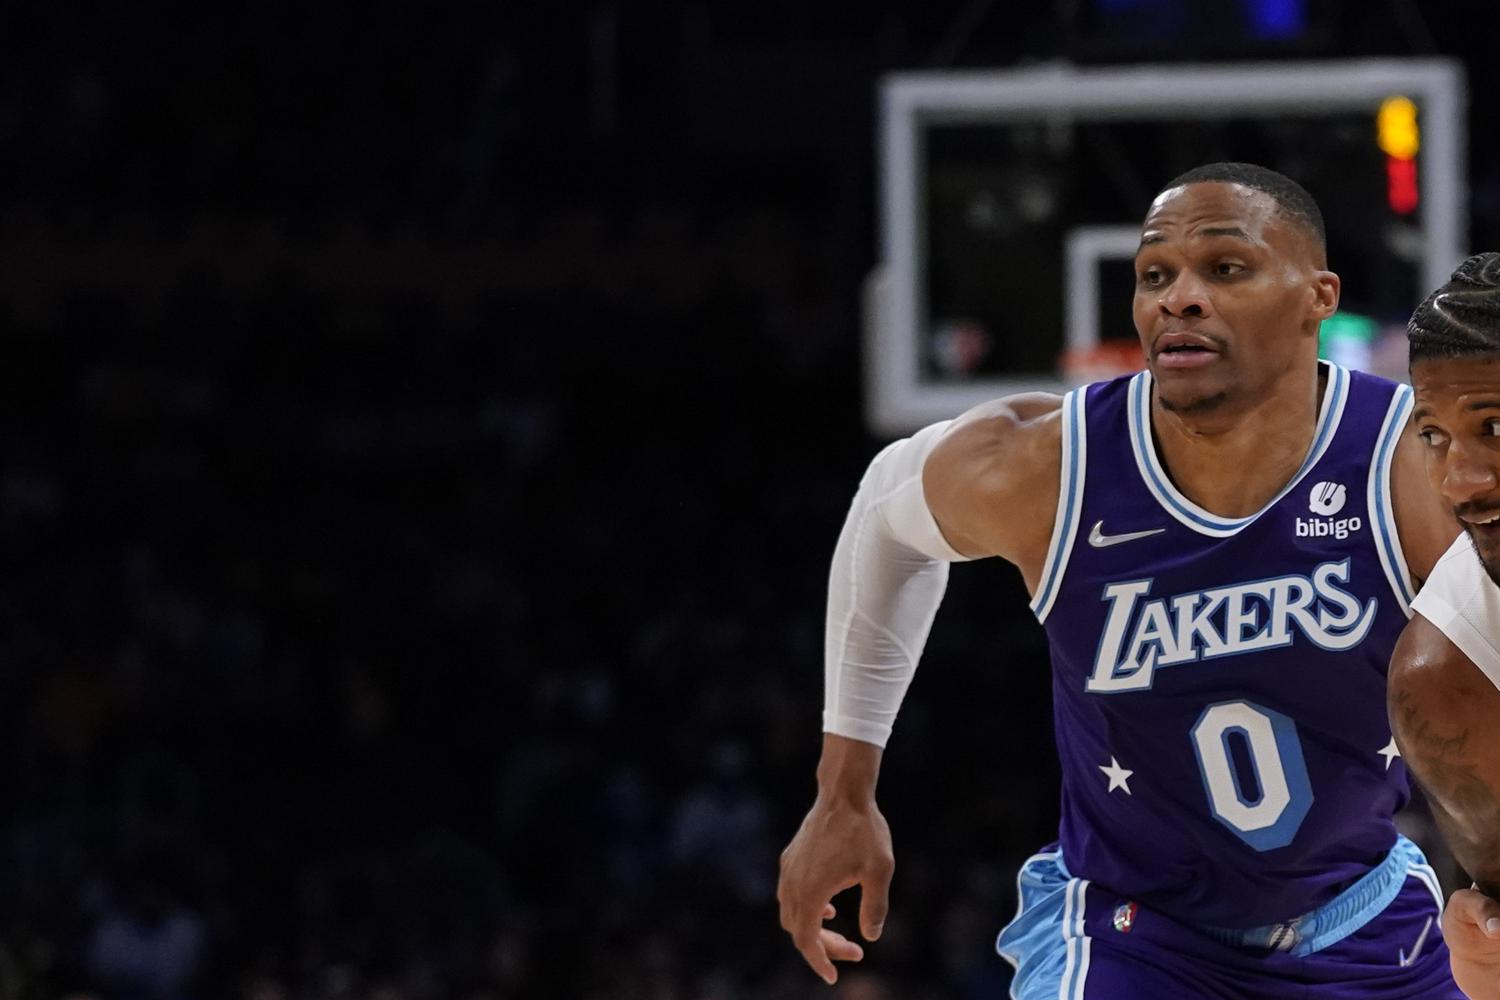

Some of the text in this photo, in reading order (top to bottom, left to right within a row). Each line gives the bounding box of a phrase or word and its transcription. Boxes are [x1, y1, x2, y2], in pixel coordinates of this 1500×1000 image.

[1295, 516, 1362, 540] bibigo
[1085, 557, 1379, 694] LAKERS
[1190, 700, 1313, 851] 0
